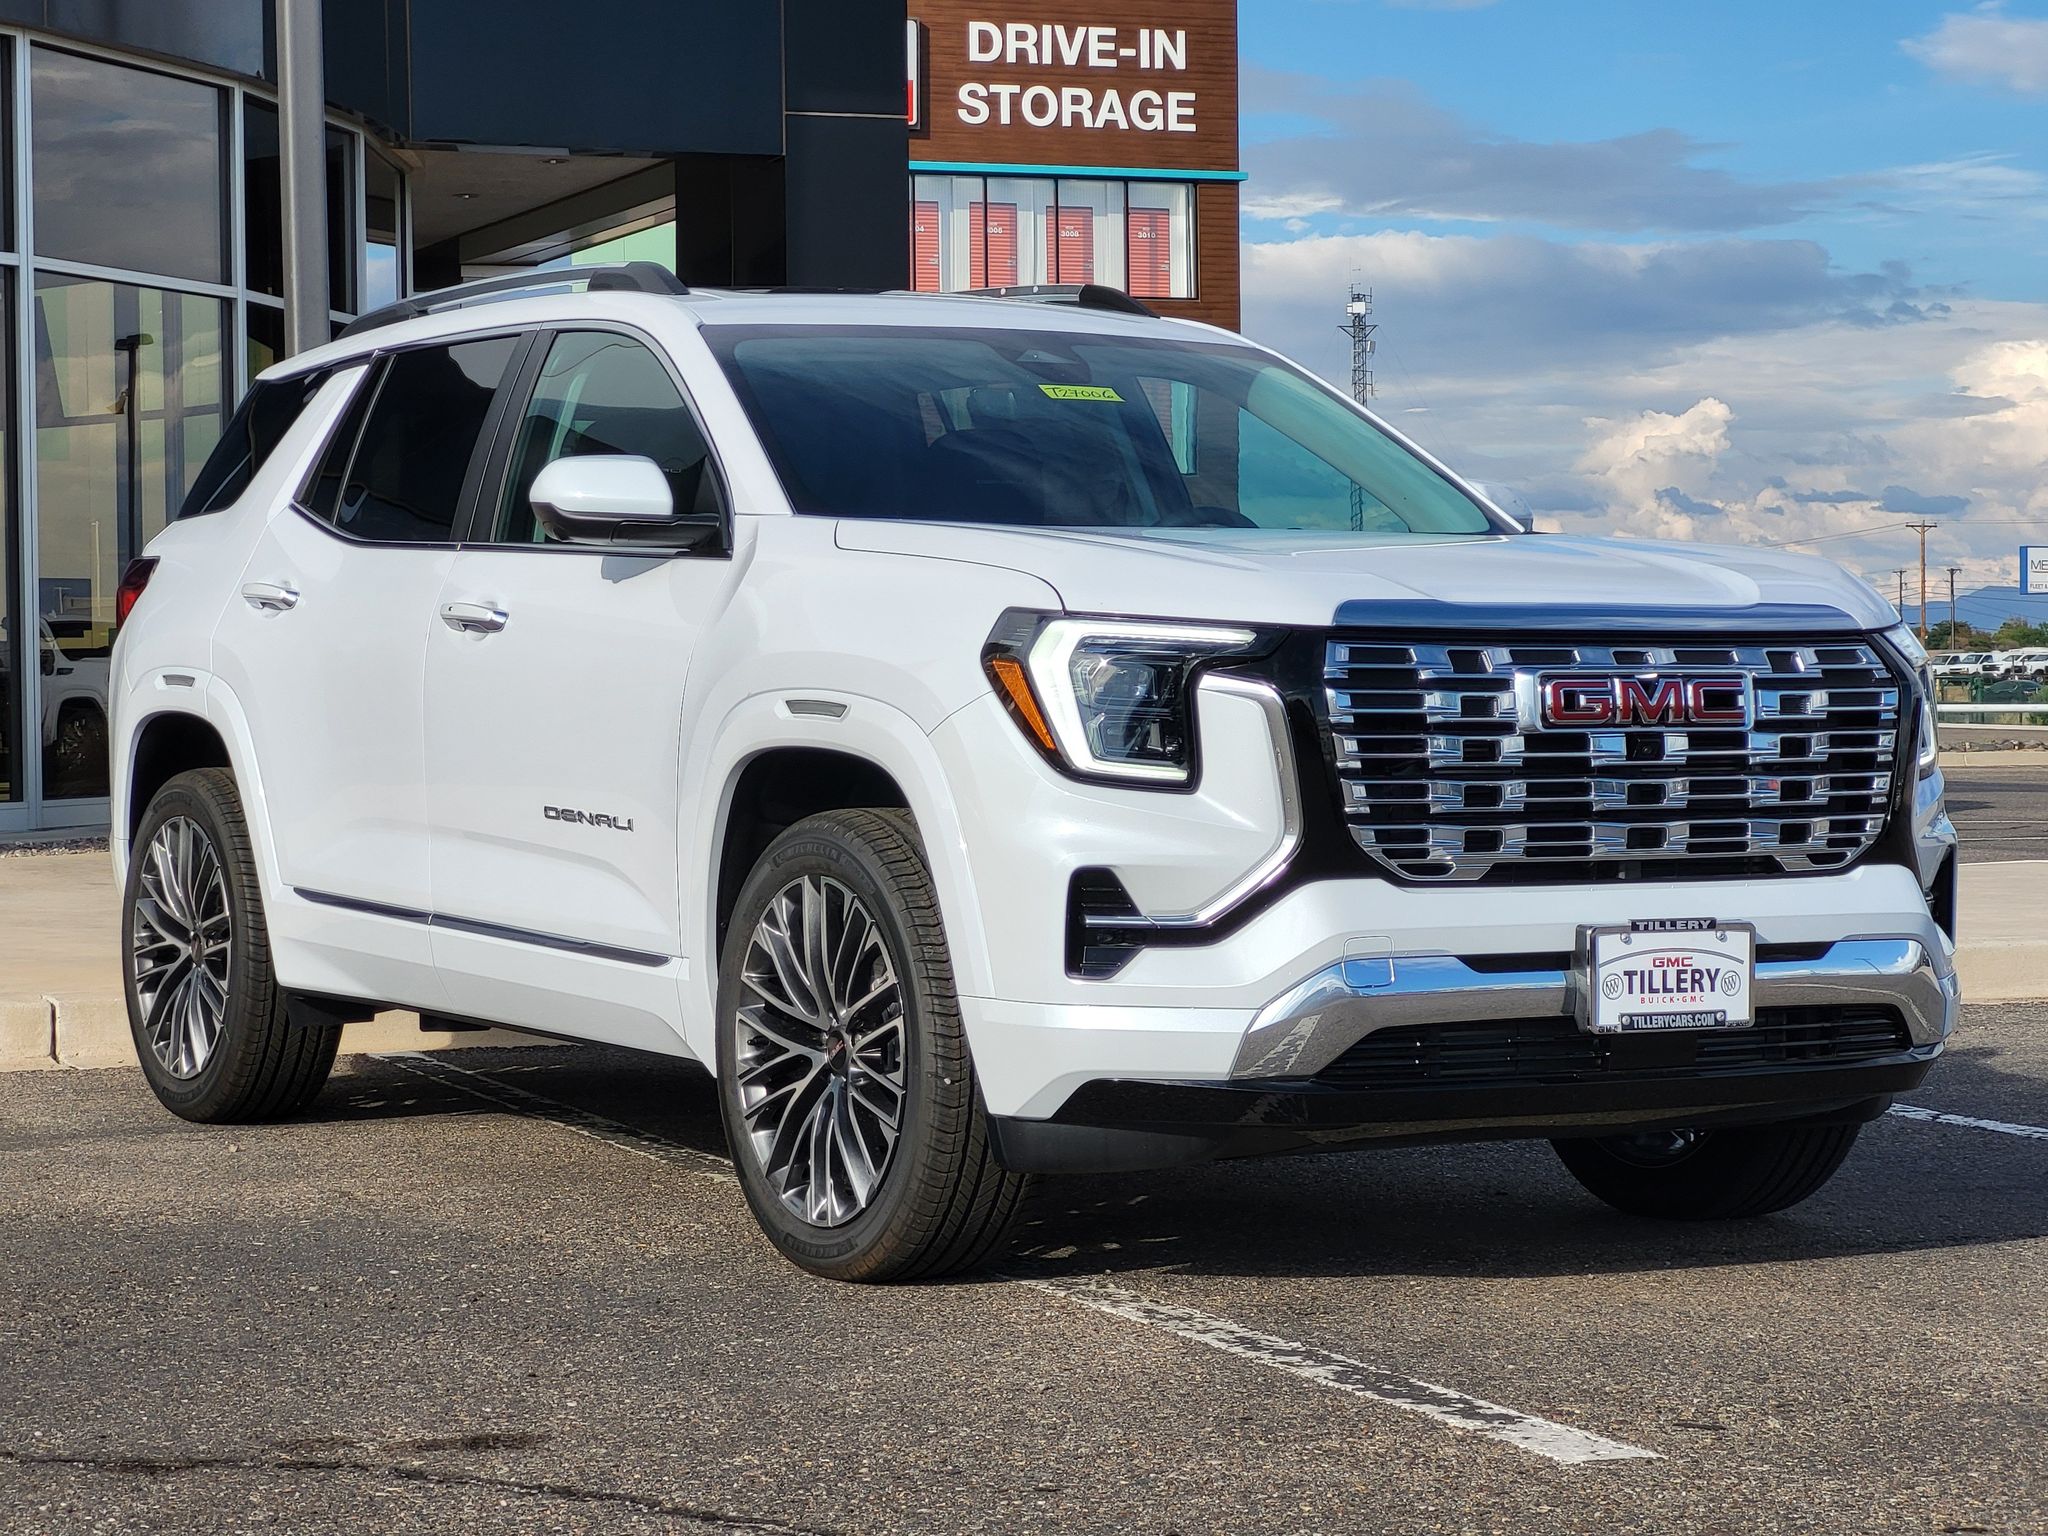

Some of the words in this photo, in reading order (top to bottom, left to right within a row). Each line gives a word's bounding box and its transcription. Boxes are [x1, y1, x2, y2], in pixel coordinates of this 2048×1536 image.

[968, 21, 1186, 70] DRIVE-IN
[957, 82, 1197, 132] STORAGE
[1137, 231, 1156, 239] 3010
[1044, 387, 1114, 399] T27006
[1546, 677, 1746, 725] GMC
[543, 805, 634, 832] DENALI
[787, 843, 838, 859] MICHELIN
[1636, 920, 1713, 931] TILLERY
[1652, 956, 1694, 968] GMC
[1623, 968, 1721, 995] TILLERY
[1632, 1012, 1715, 1029] TILLERYCARS.COM
